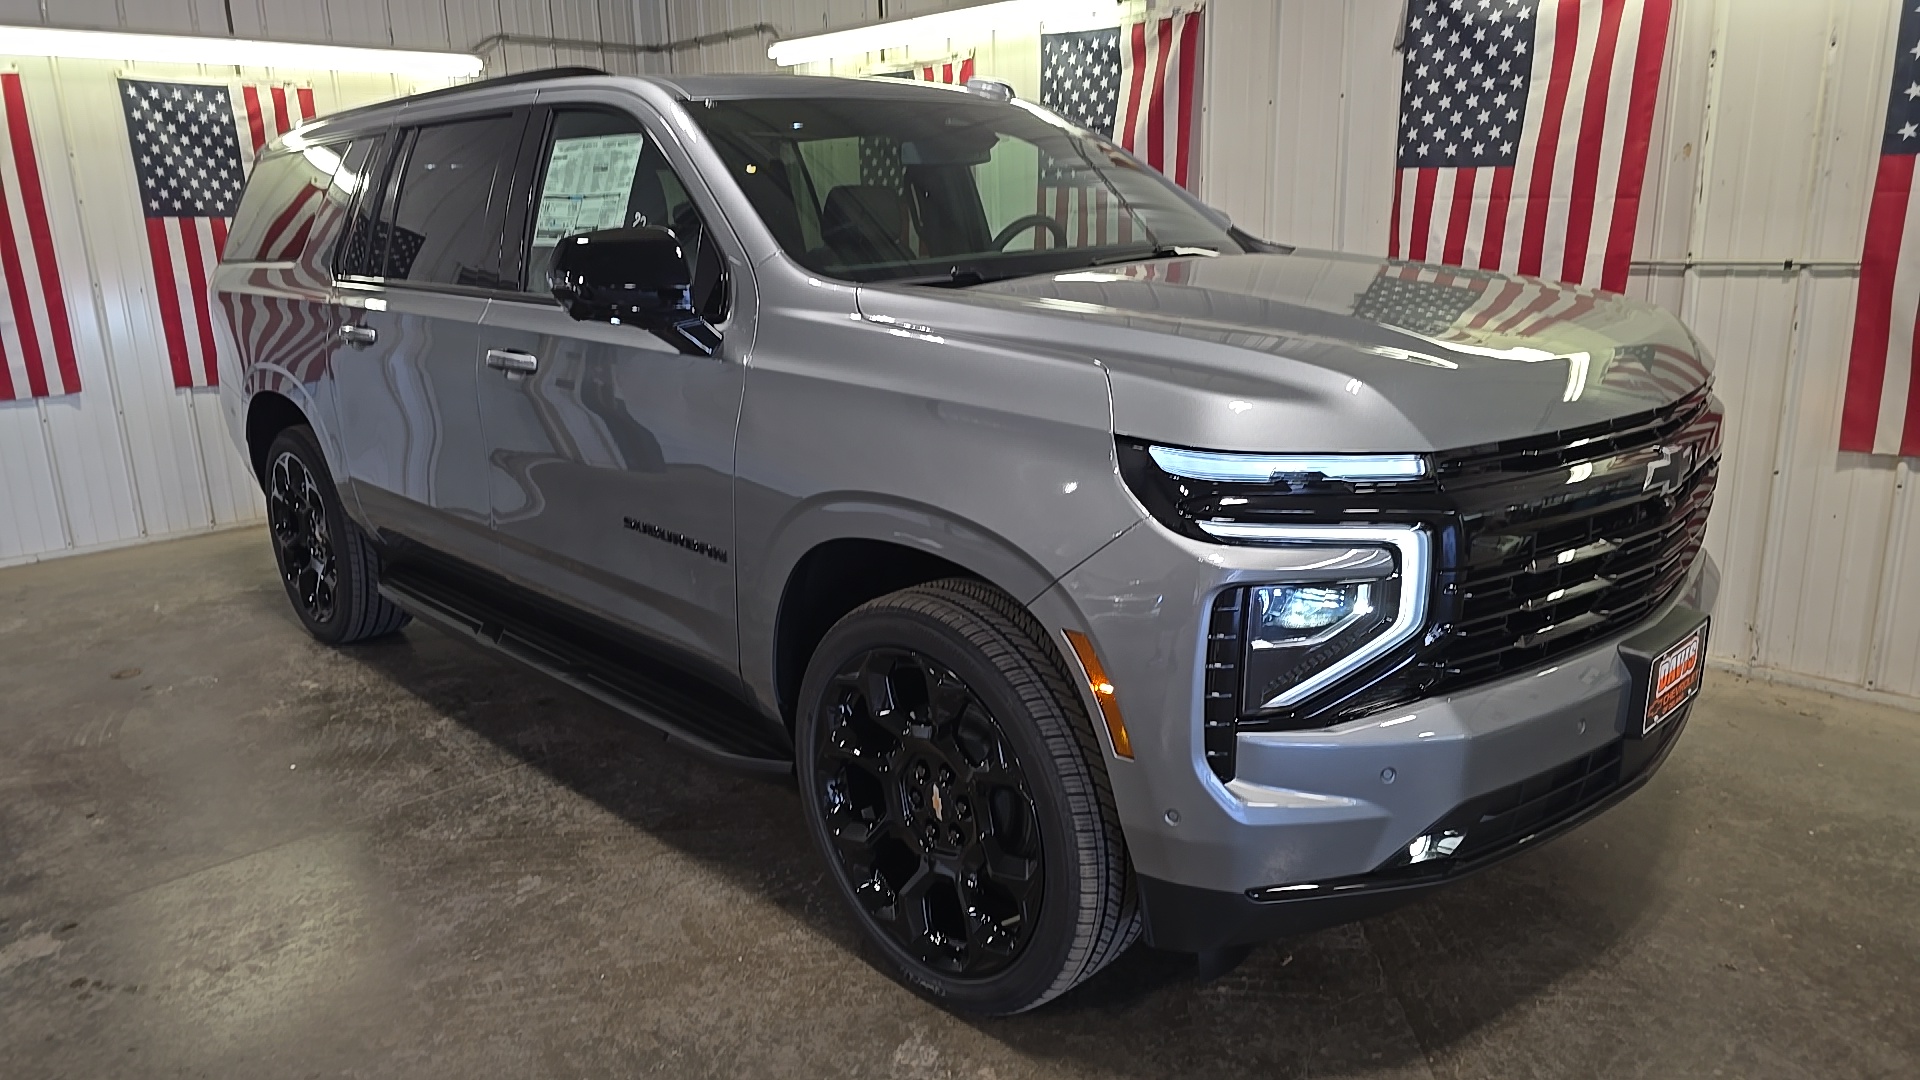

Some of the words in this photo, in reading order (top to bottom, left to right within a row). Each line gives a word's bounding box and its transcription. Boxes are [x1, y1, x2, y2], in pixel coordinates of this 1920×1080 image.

[623, 516, 728, 563] SUBURBAN
[1658, 641, 1697, 692] DAVIS
[1662, 669, 1699, 704] CHEVROLET
